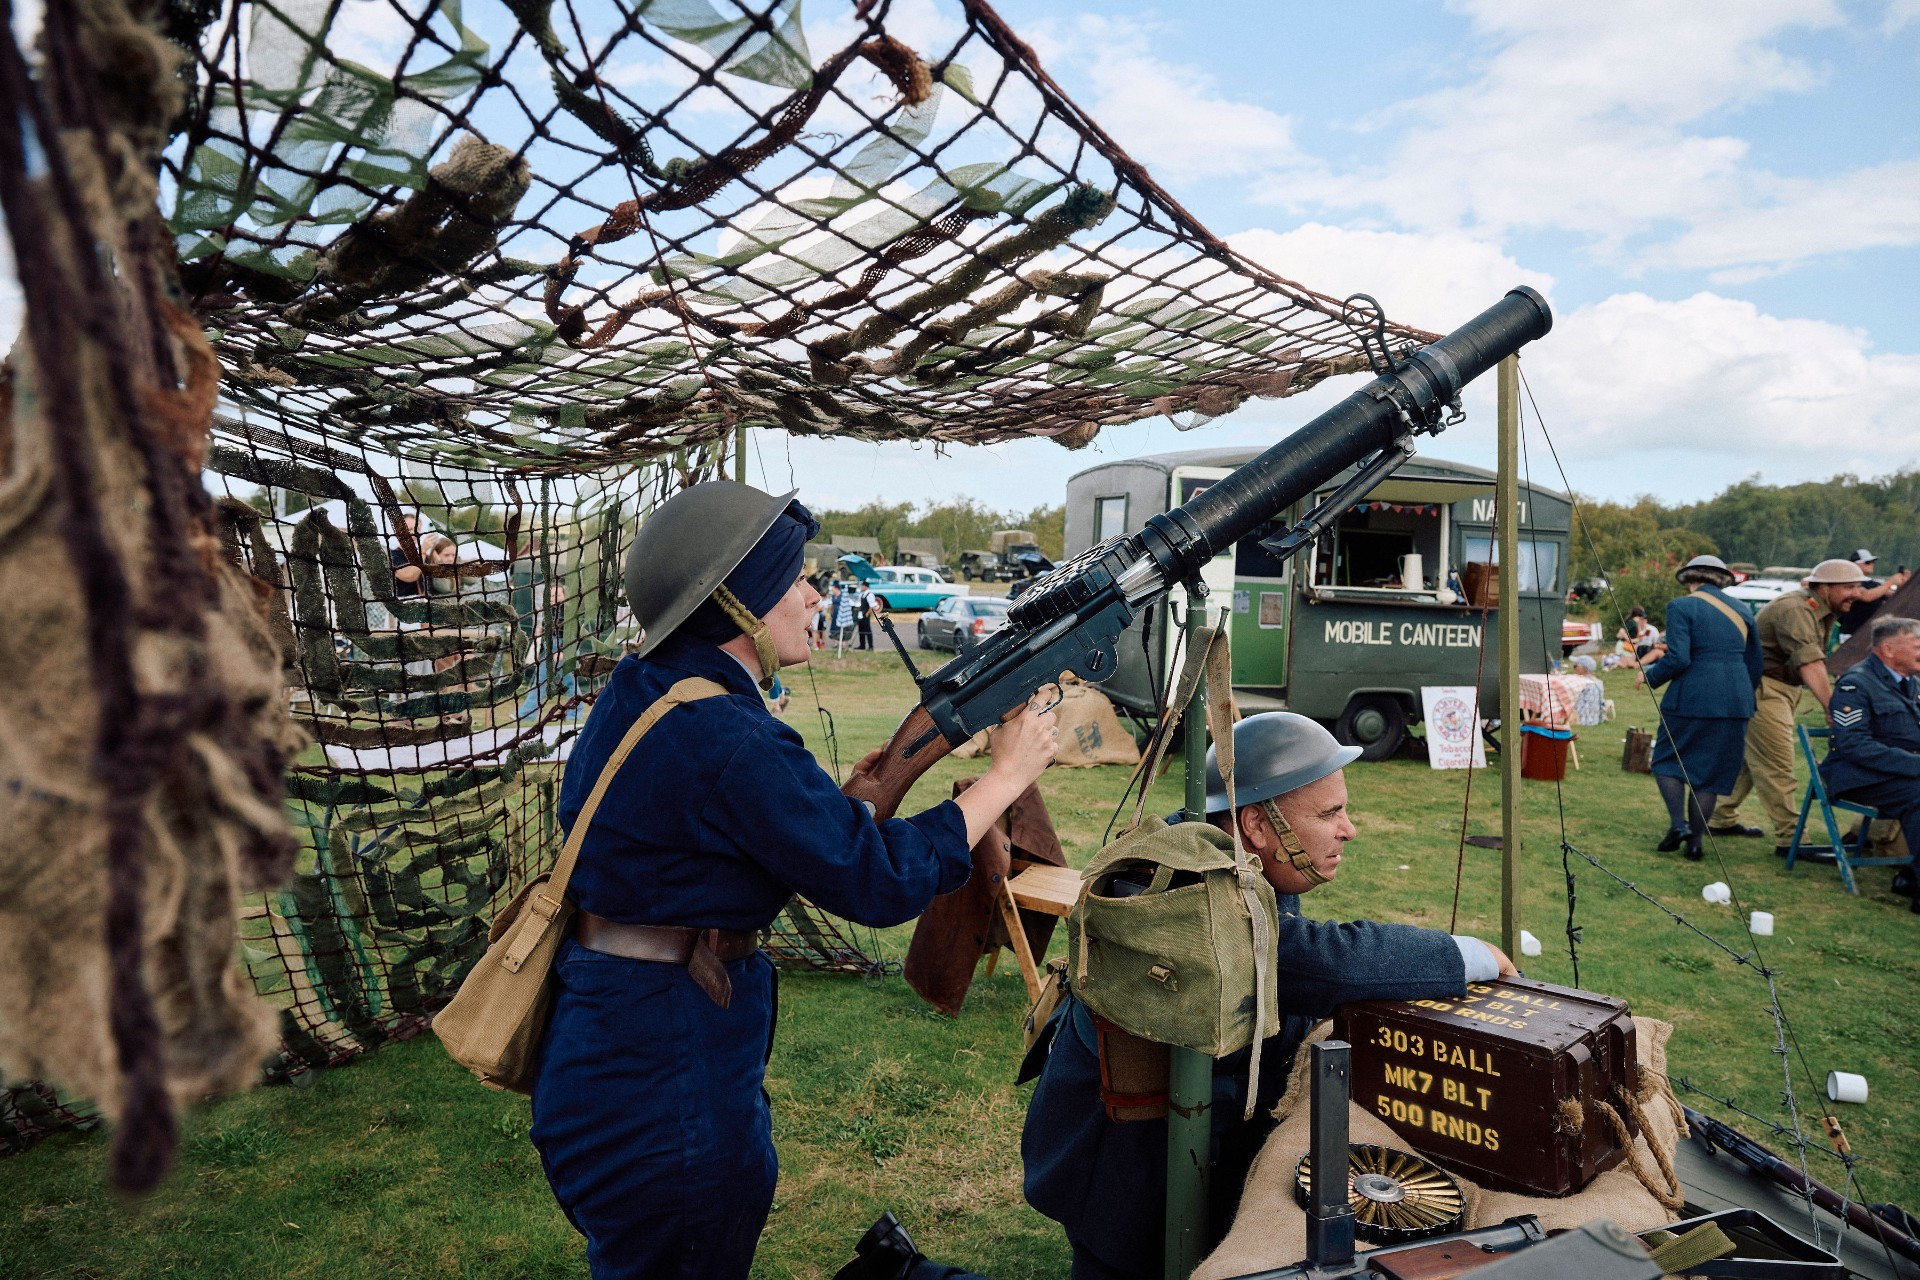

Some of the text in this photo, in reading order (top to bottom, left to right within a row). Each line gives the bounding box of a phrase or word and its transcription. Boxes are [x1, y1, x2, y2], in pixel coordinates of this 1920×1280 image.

[1472, 498, 1526, 524] NAI
[1324, 620, 1482, 648] MOBILE CANTEEN
[1485, 1001, 1540, 1018] BLT
[1494, 989, 1562, 1011] BALL
[1454, 1007, 1528, 1029] RNDS
[1370, 1026, 1500, 1077] .303 BALL
[1384, 1062, 1491, 1111] MK7 BLT
[1377, 1094, 1499, 1151] 500 RNDS
